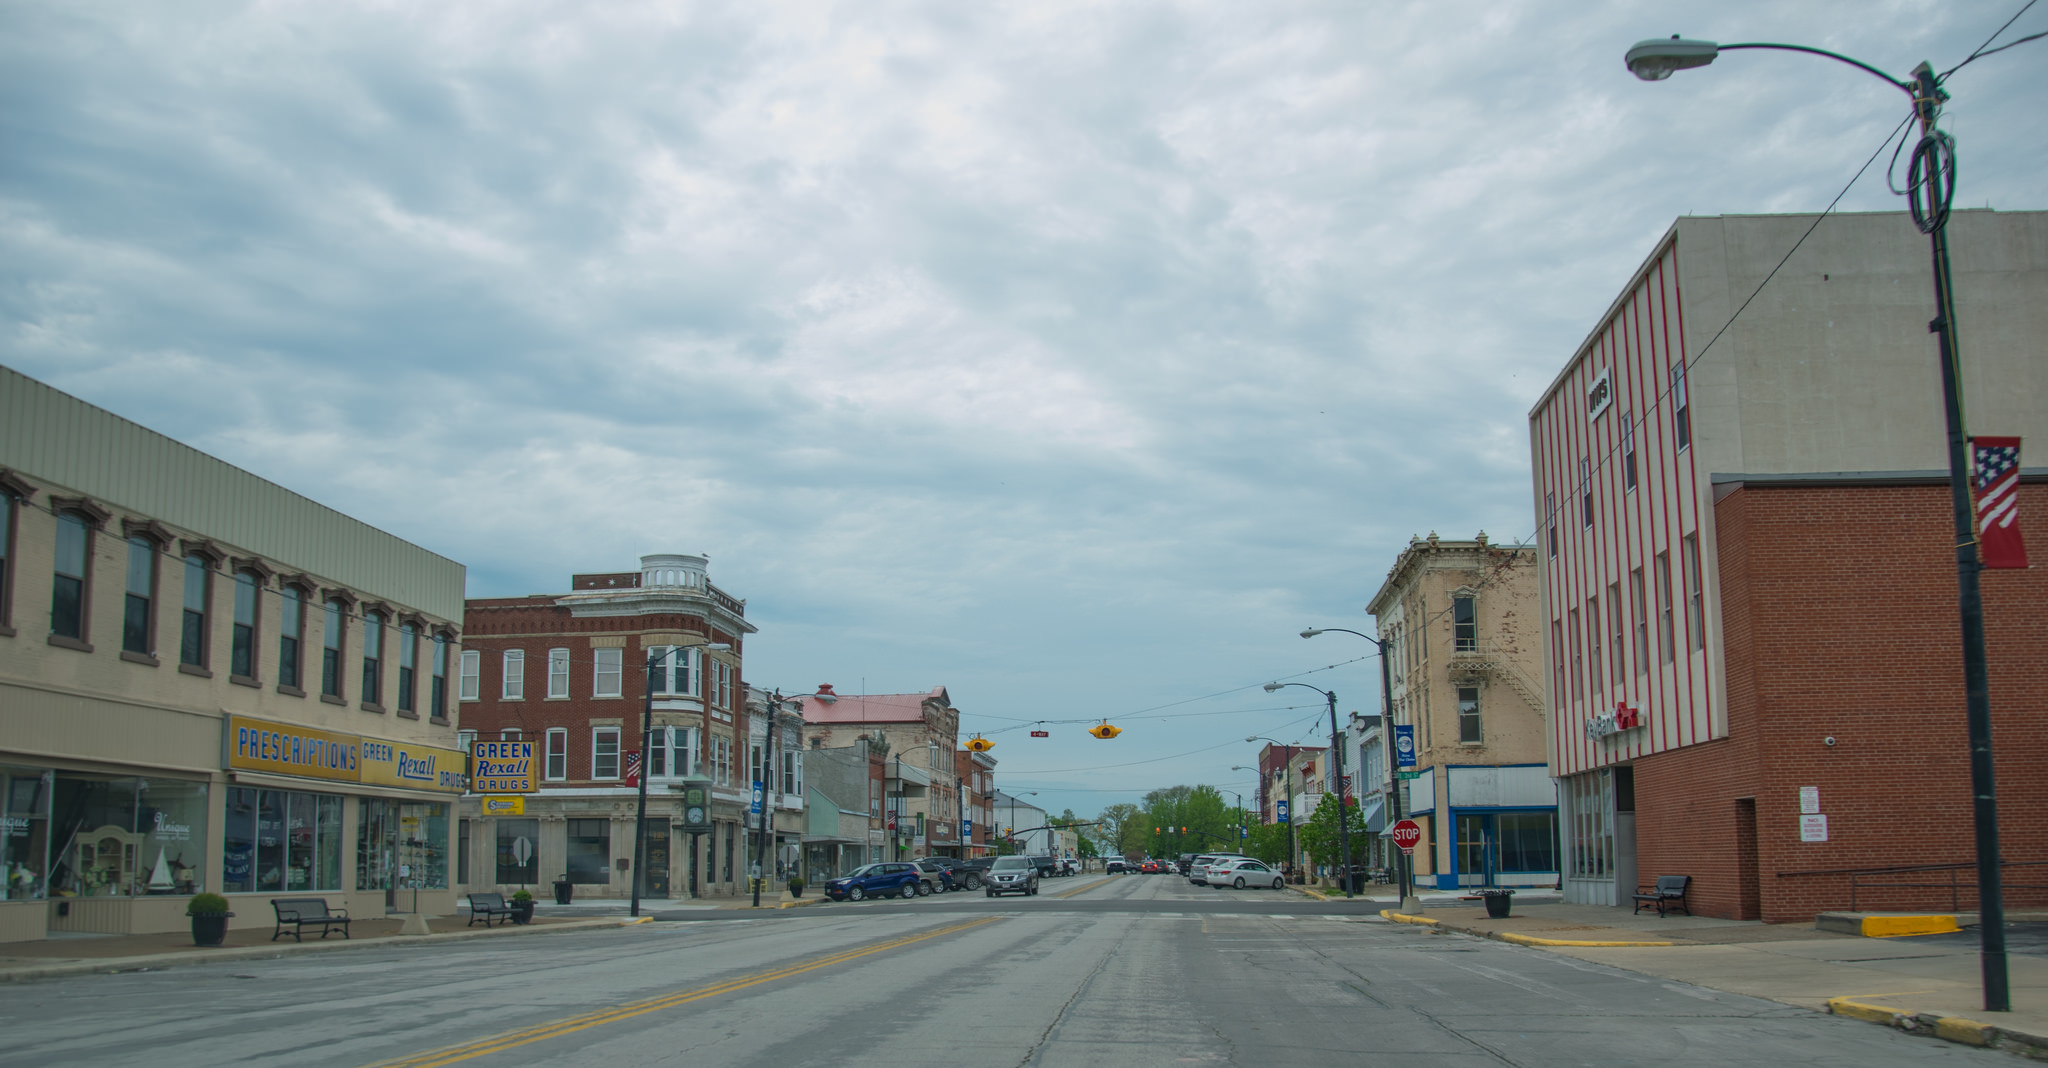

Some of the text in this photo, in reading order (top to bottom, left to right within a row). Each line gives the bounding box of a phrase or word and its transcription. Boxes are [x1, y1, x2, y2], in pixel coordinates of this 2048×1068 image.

[1585, 711, 1617, 742] KeyBank
[237, 726, 357, 771] PRESCRIPTIONS
[363, 741, 393, 763] GREEN
[476, 743, 531, 758] GREEN
[397, 751, 436, 782] Rexall
[476, 759, 529, 777] Rexall
[439, 770, 466, 789] DRUGS
[477, 779, 529, 790] DRUGS
[153, 811, 191, 837] Unique
[1394, 828, 1419, 841] STOP
